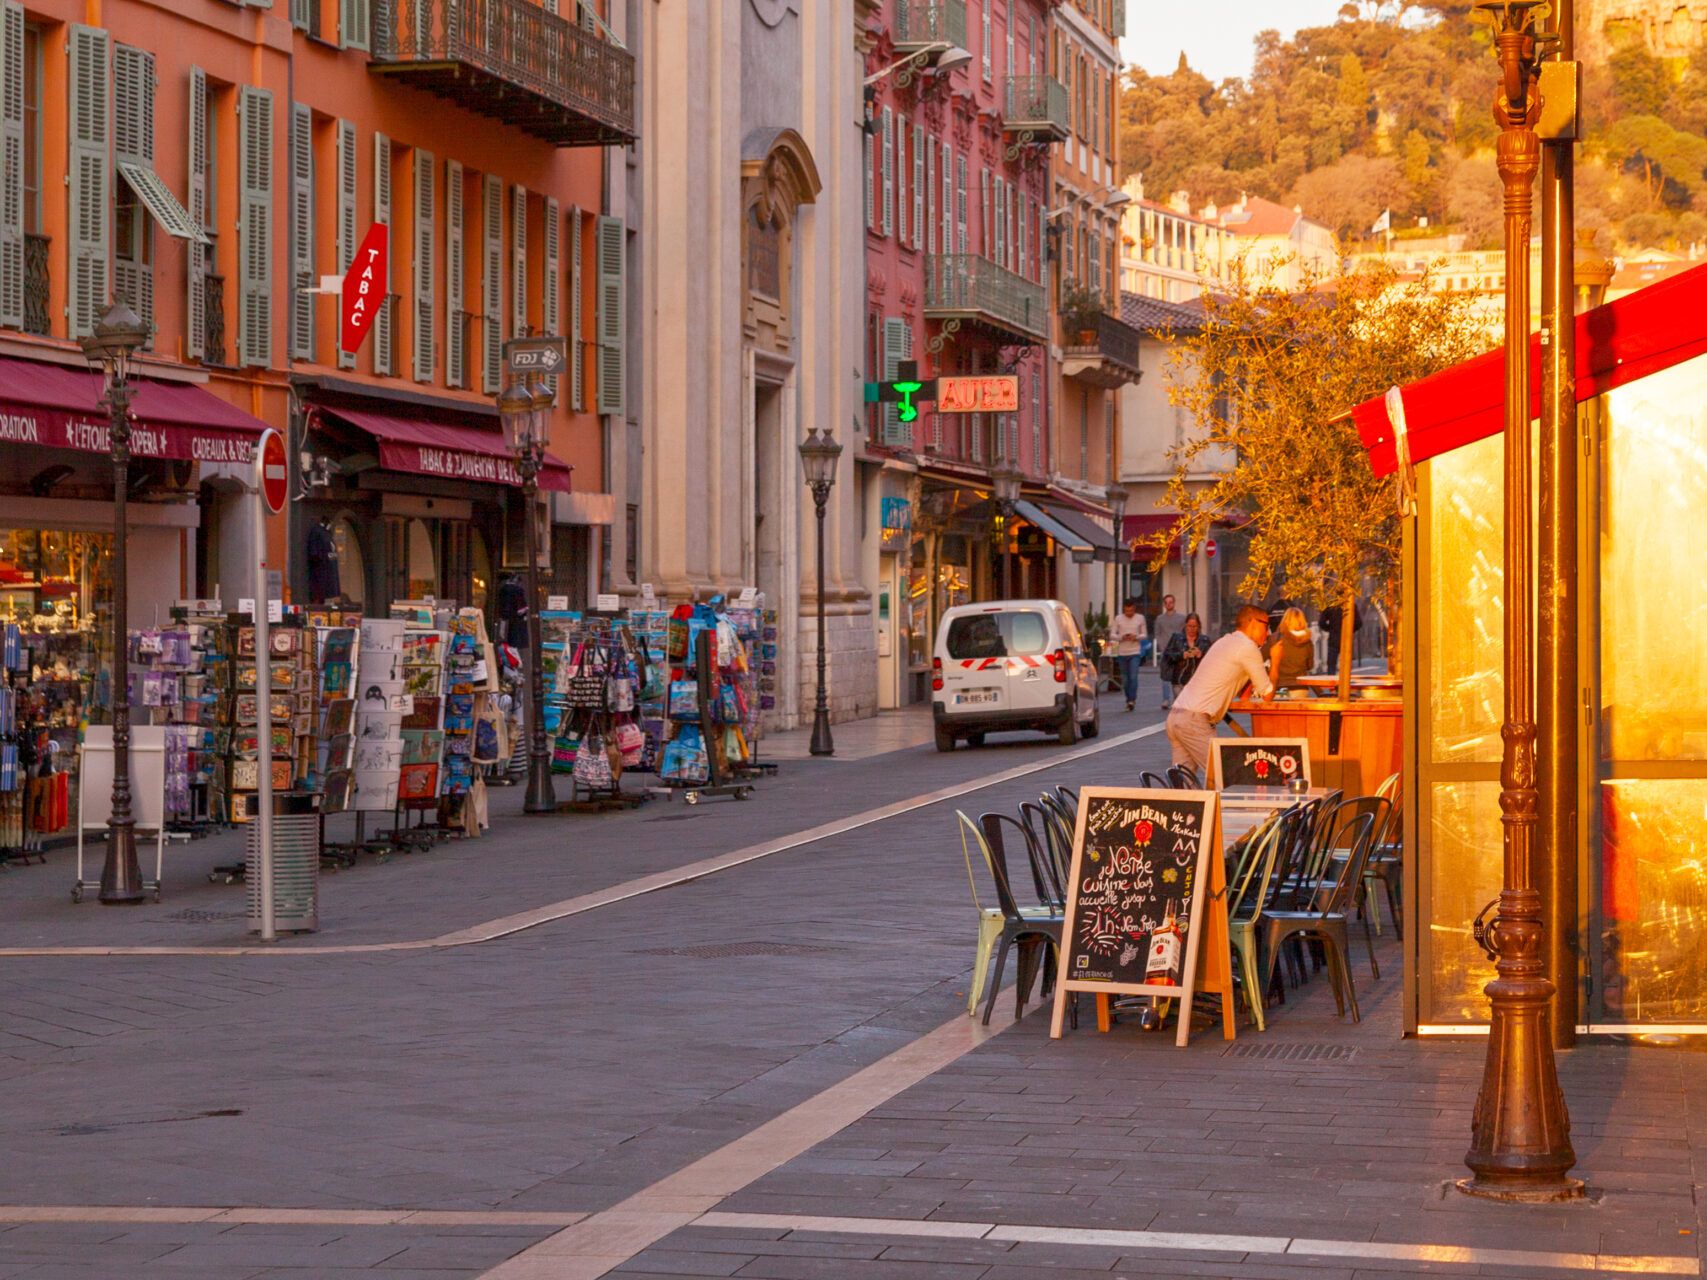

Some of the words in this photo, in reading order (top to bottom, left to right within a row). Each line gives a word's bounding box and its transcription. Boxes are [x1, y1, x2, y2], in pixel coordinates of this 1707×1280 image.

[351, 249, 379, 326] TABAC
[514, 352, 537, 365] FDJ
[940, 378, 1016, 410] AUER
[191, 437, 228, 460] CADEAUX
[228, 439, 236, 460] &
[418, 448, 444, 473] TABAC
[445, 451, 453, 474] &
[1243, 751, 1258, 766] JIM
[1257, 749, 1278, 766] BEAM
[1120, 808, 1141, 828] JIM
[1141, 805, 1168, 831] BEAM
